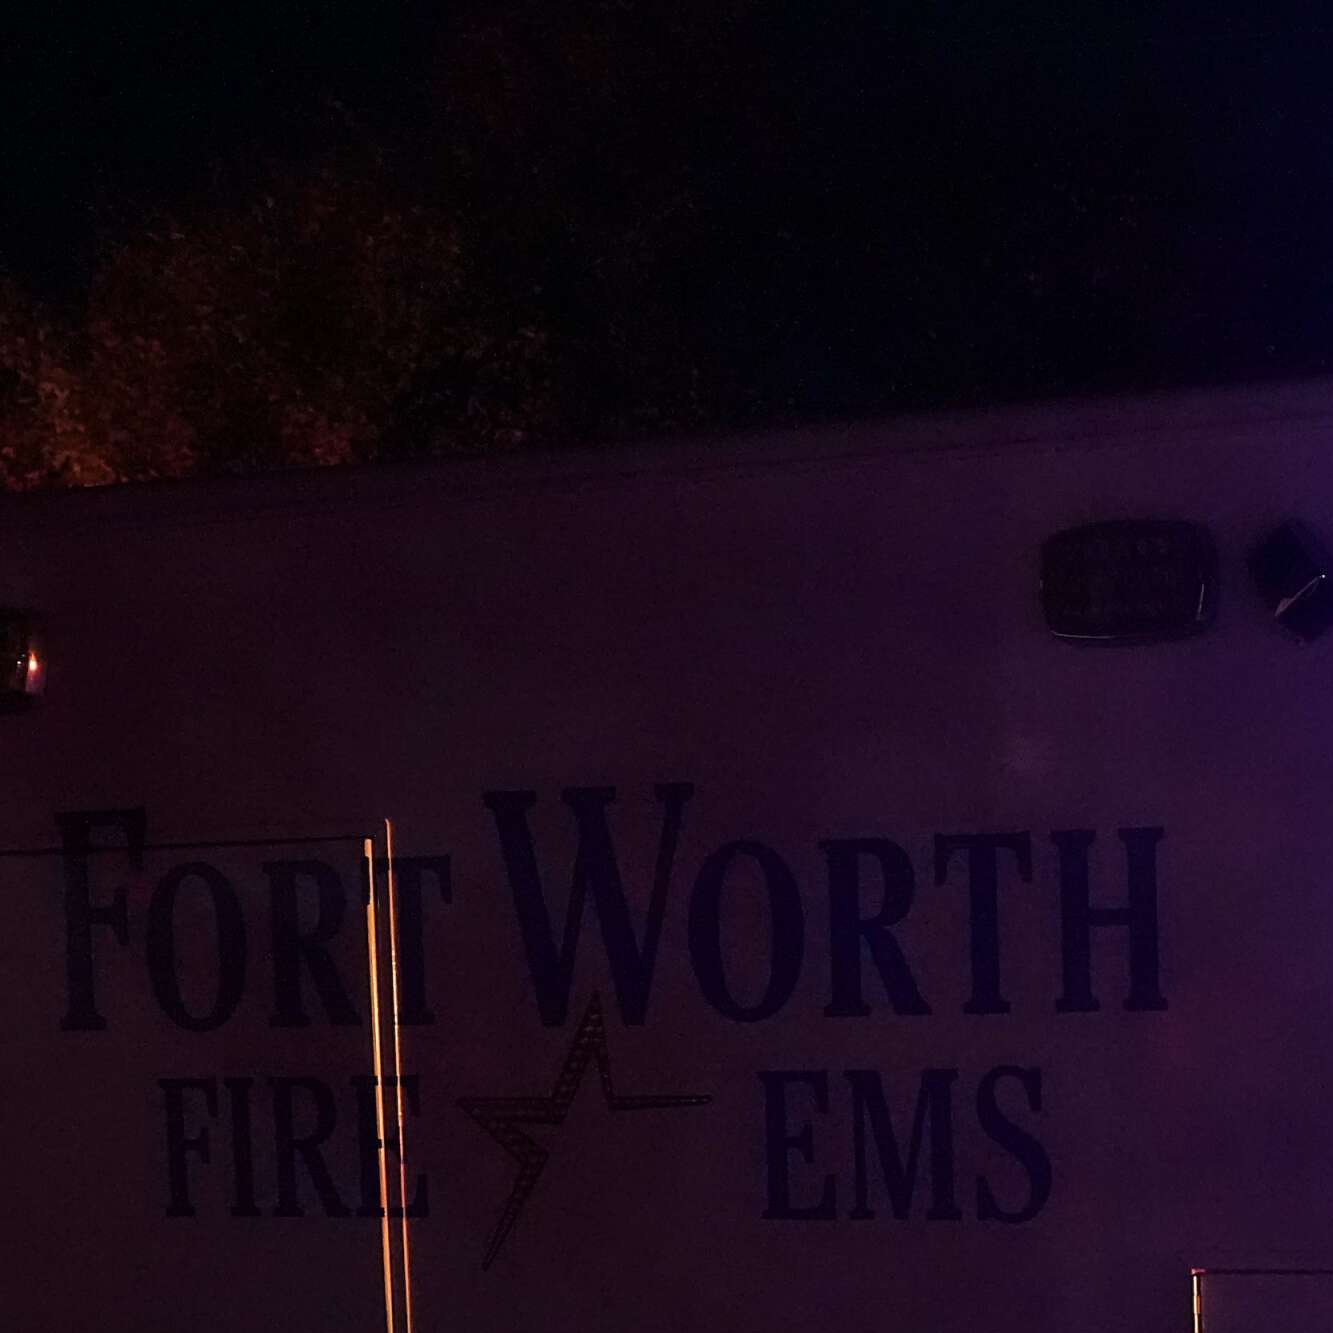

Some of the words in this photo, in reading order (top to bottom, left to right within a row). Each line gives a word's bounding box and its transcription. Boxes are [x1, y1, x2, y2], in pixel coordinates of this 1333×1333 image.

[53, 807, 452, 1032] FORT
[484, 783, 1168, 1027] WORTH
[159, 1074, 429, 1220] FIRE
[757, 1066, 1053, 1225] EMS
